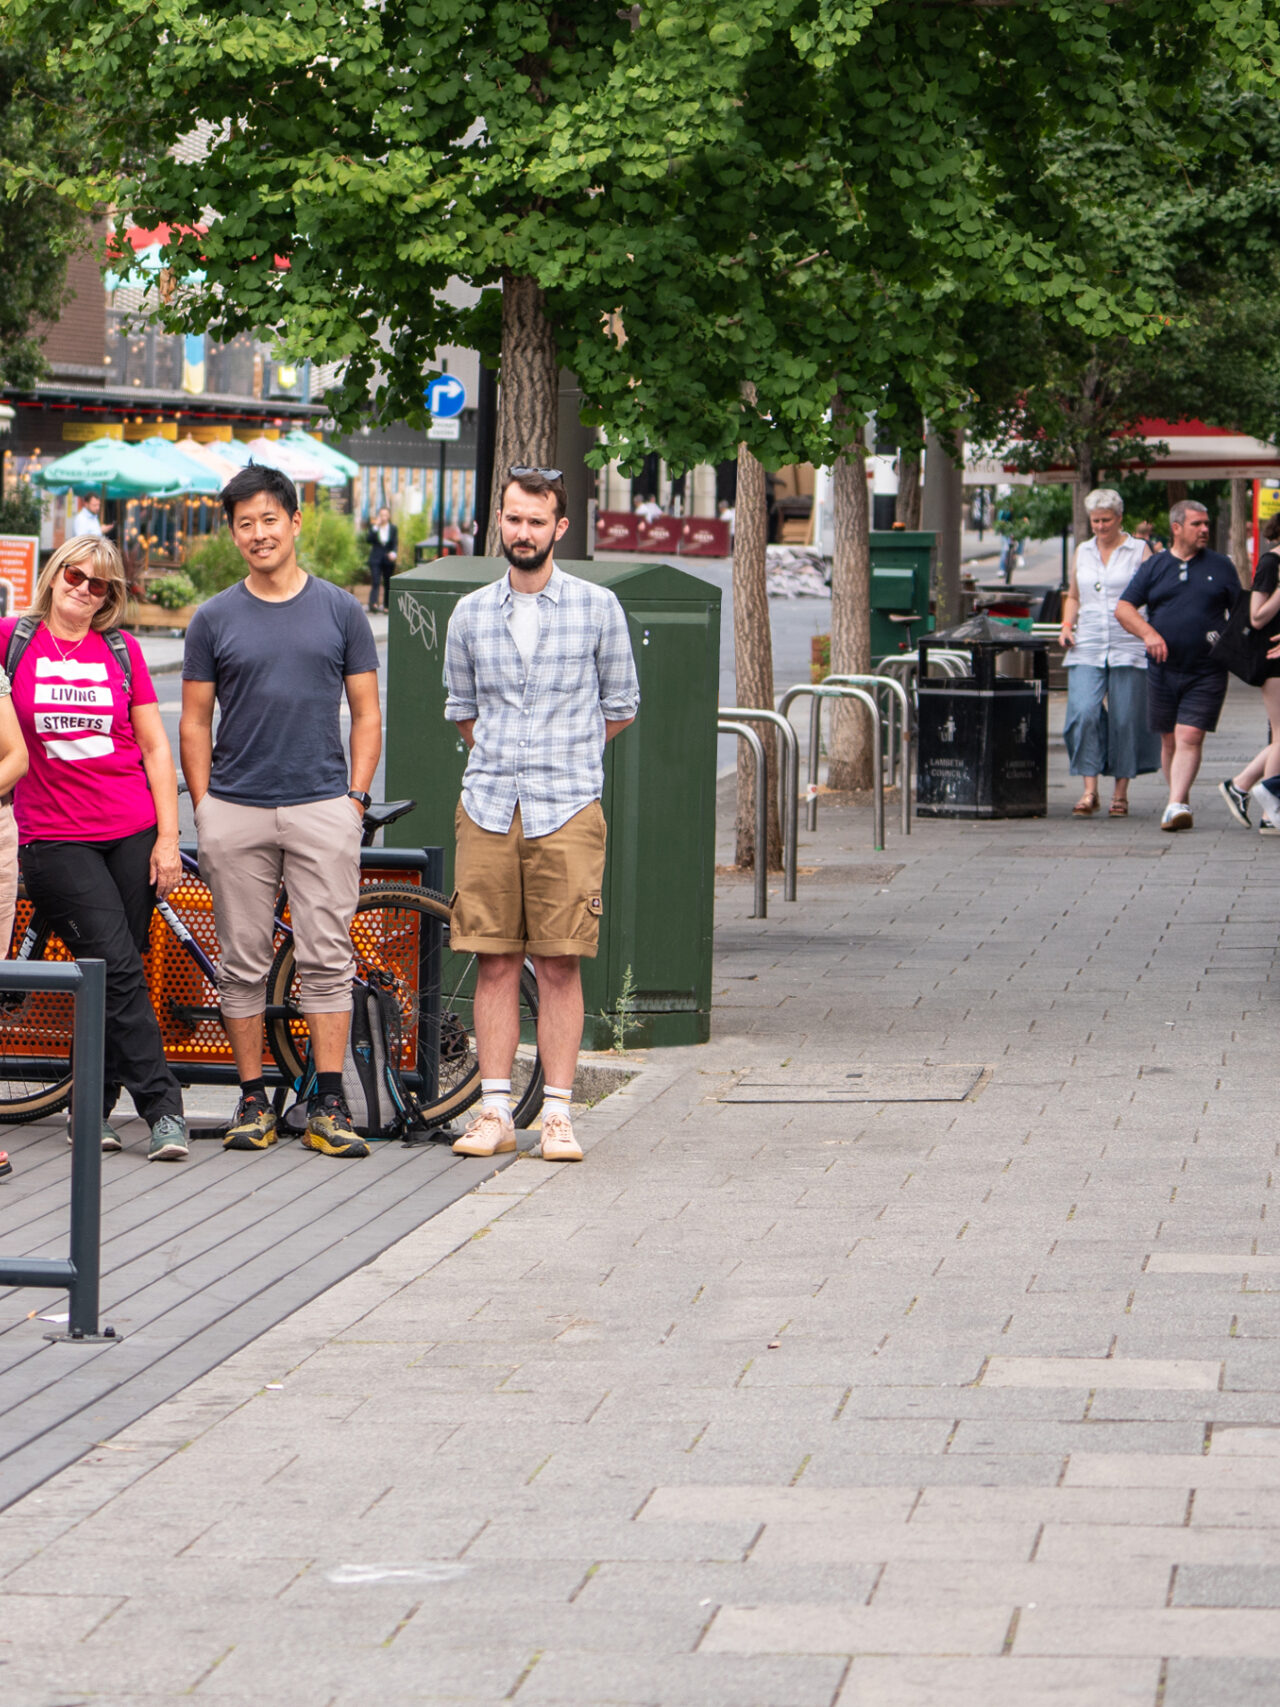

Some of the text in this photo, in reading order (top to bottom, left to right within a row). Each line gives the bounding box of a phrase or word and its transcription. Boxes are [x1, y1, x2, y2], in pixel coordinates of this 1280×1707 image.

[51, 688, 97, 702] LIVING
[43, 716, 104, 730] STREETS
[930, 758, 964, 767] LAMBETH
[931, 769, 962, 779] COUNCIL
